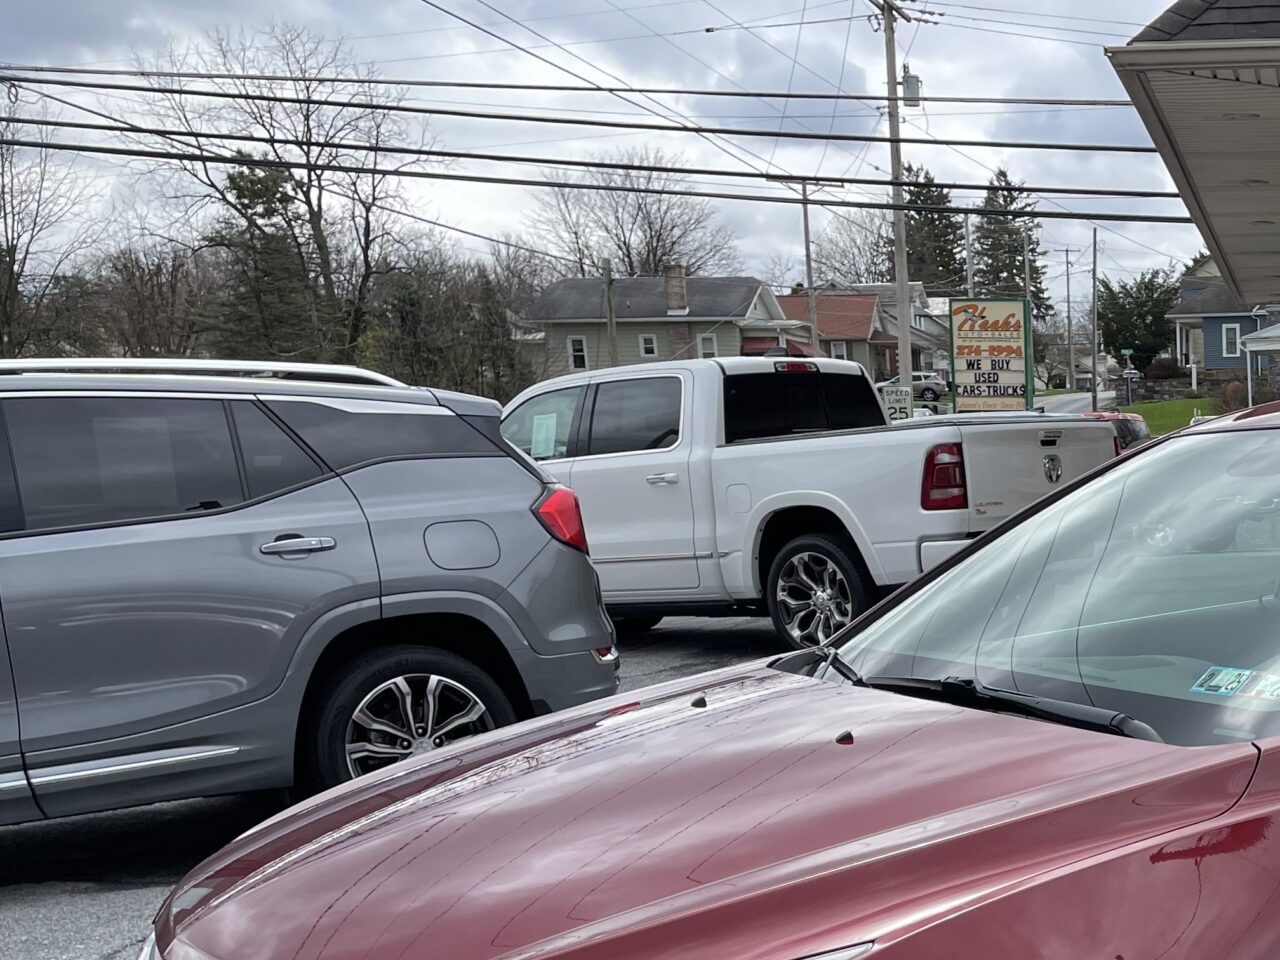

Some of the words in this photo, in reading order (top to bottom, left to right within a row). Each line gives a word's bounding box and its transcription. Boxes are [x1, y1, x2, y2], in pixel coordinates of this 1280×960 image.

[966, 359, 982, 371] WE
[991, 359, 1011, 371] BUY
[974, 372, 999, 383] USED
[885, 389, 910, 397] SPEED
[956, 384, 1025, 396] CARS-TRUCKS
[887, 406, 909, 420] 25
